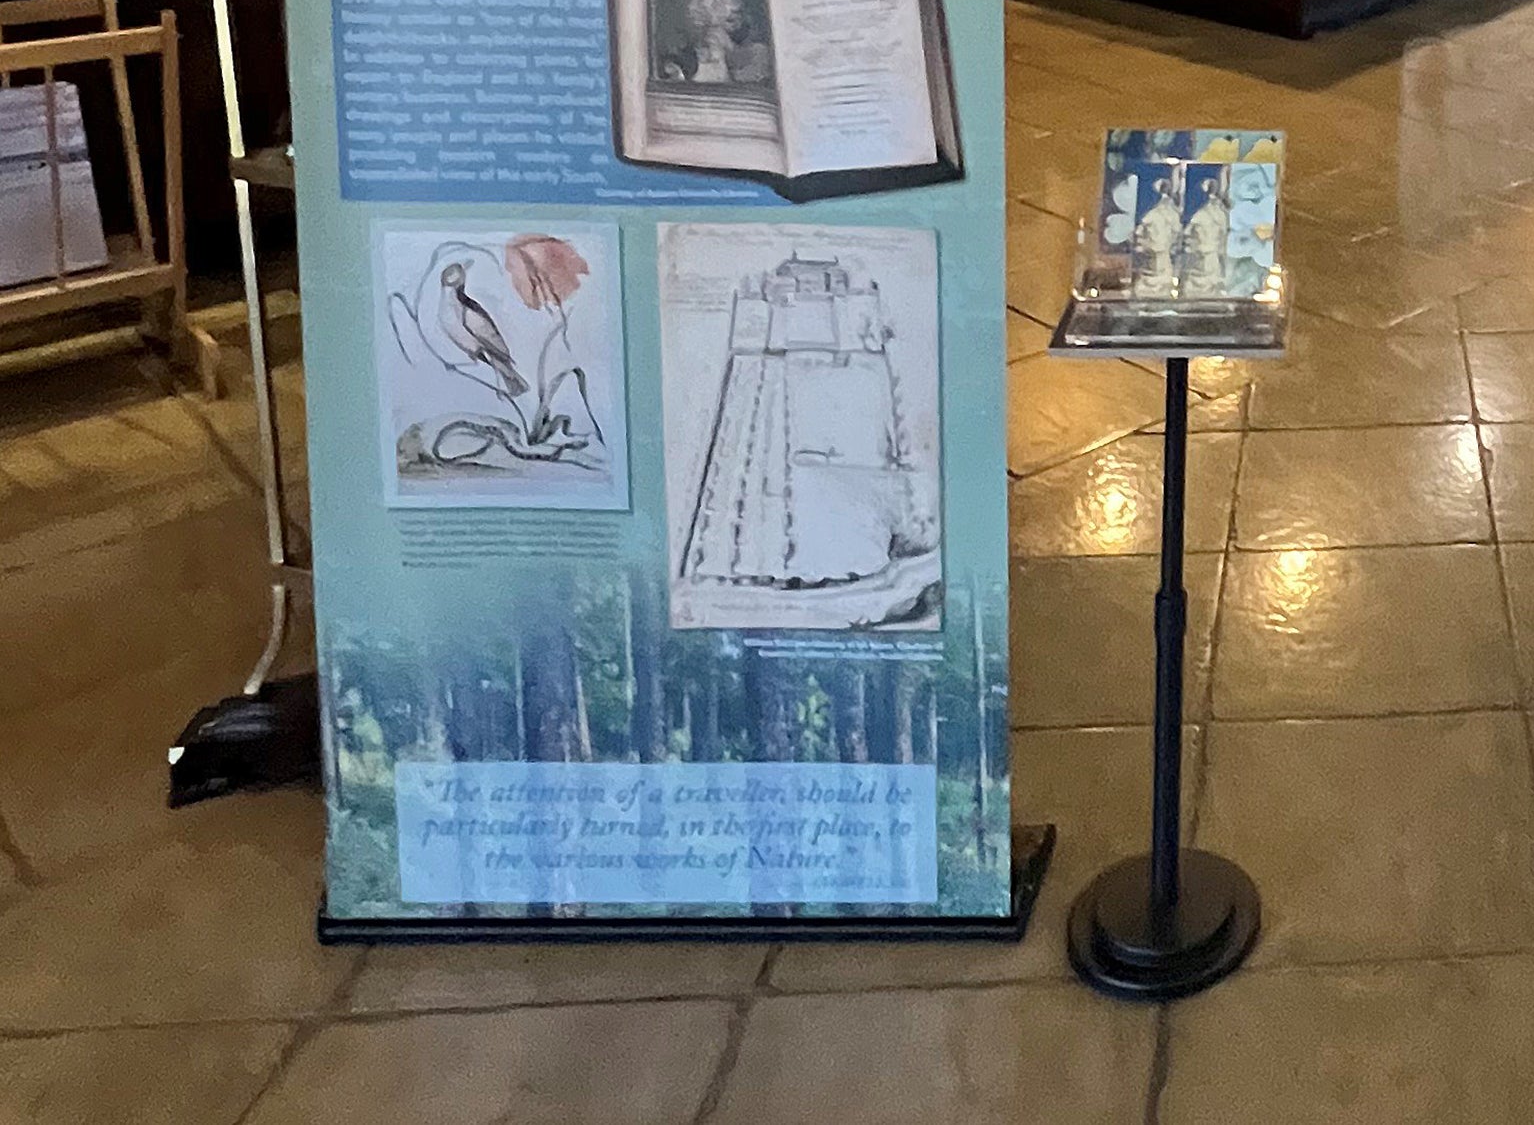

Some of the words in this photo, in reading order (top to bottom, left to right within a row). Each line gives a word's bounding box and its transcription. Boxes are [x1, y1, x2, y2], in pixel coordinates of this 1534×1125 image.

[616, 780, 645, 812] of
[649, 787, 663, 803] a
[796, 779, 875, 804] should
[886, 780, 912, 805] be
[680, 819, 704, 837] in
[890, 818, 912, 837] to
[485, 846, 523, 868] the
[715, 845, 744, 878] of
